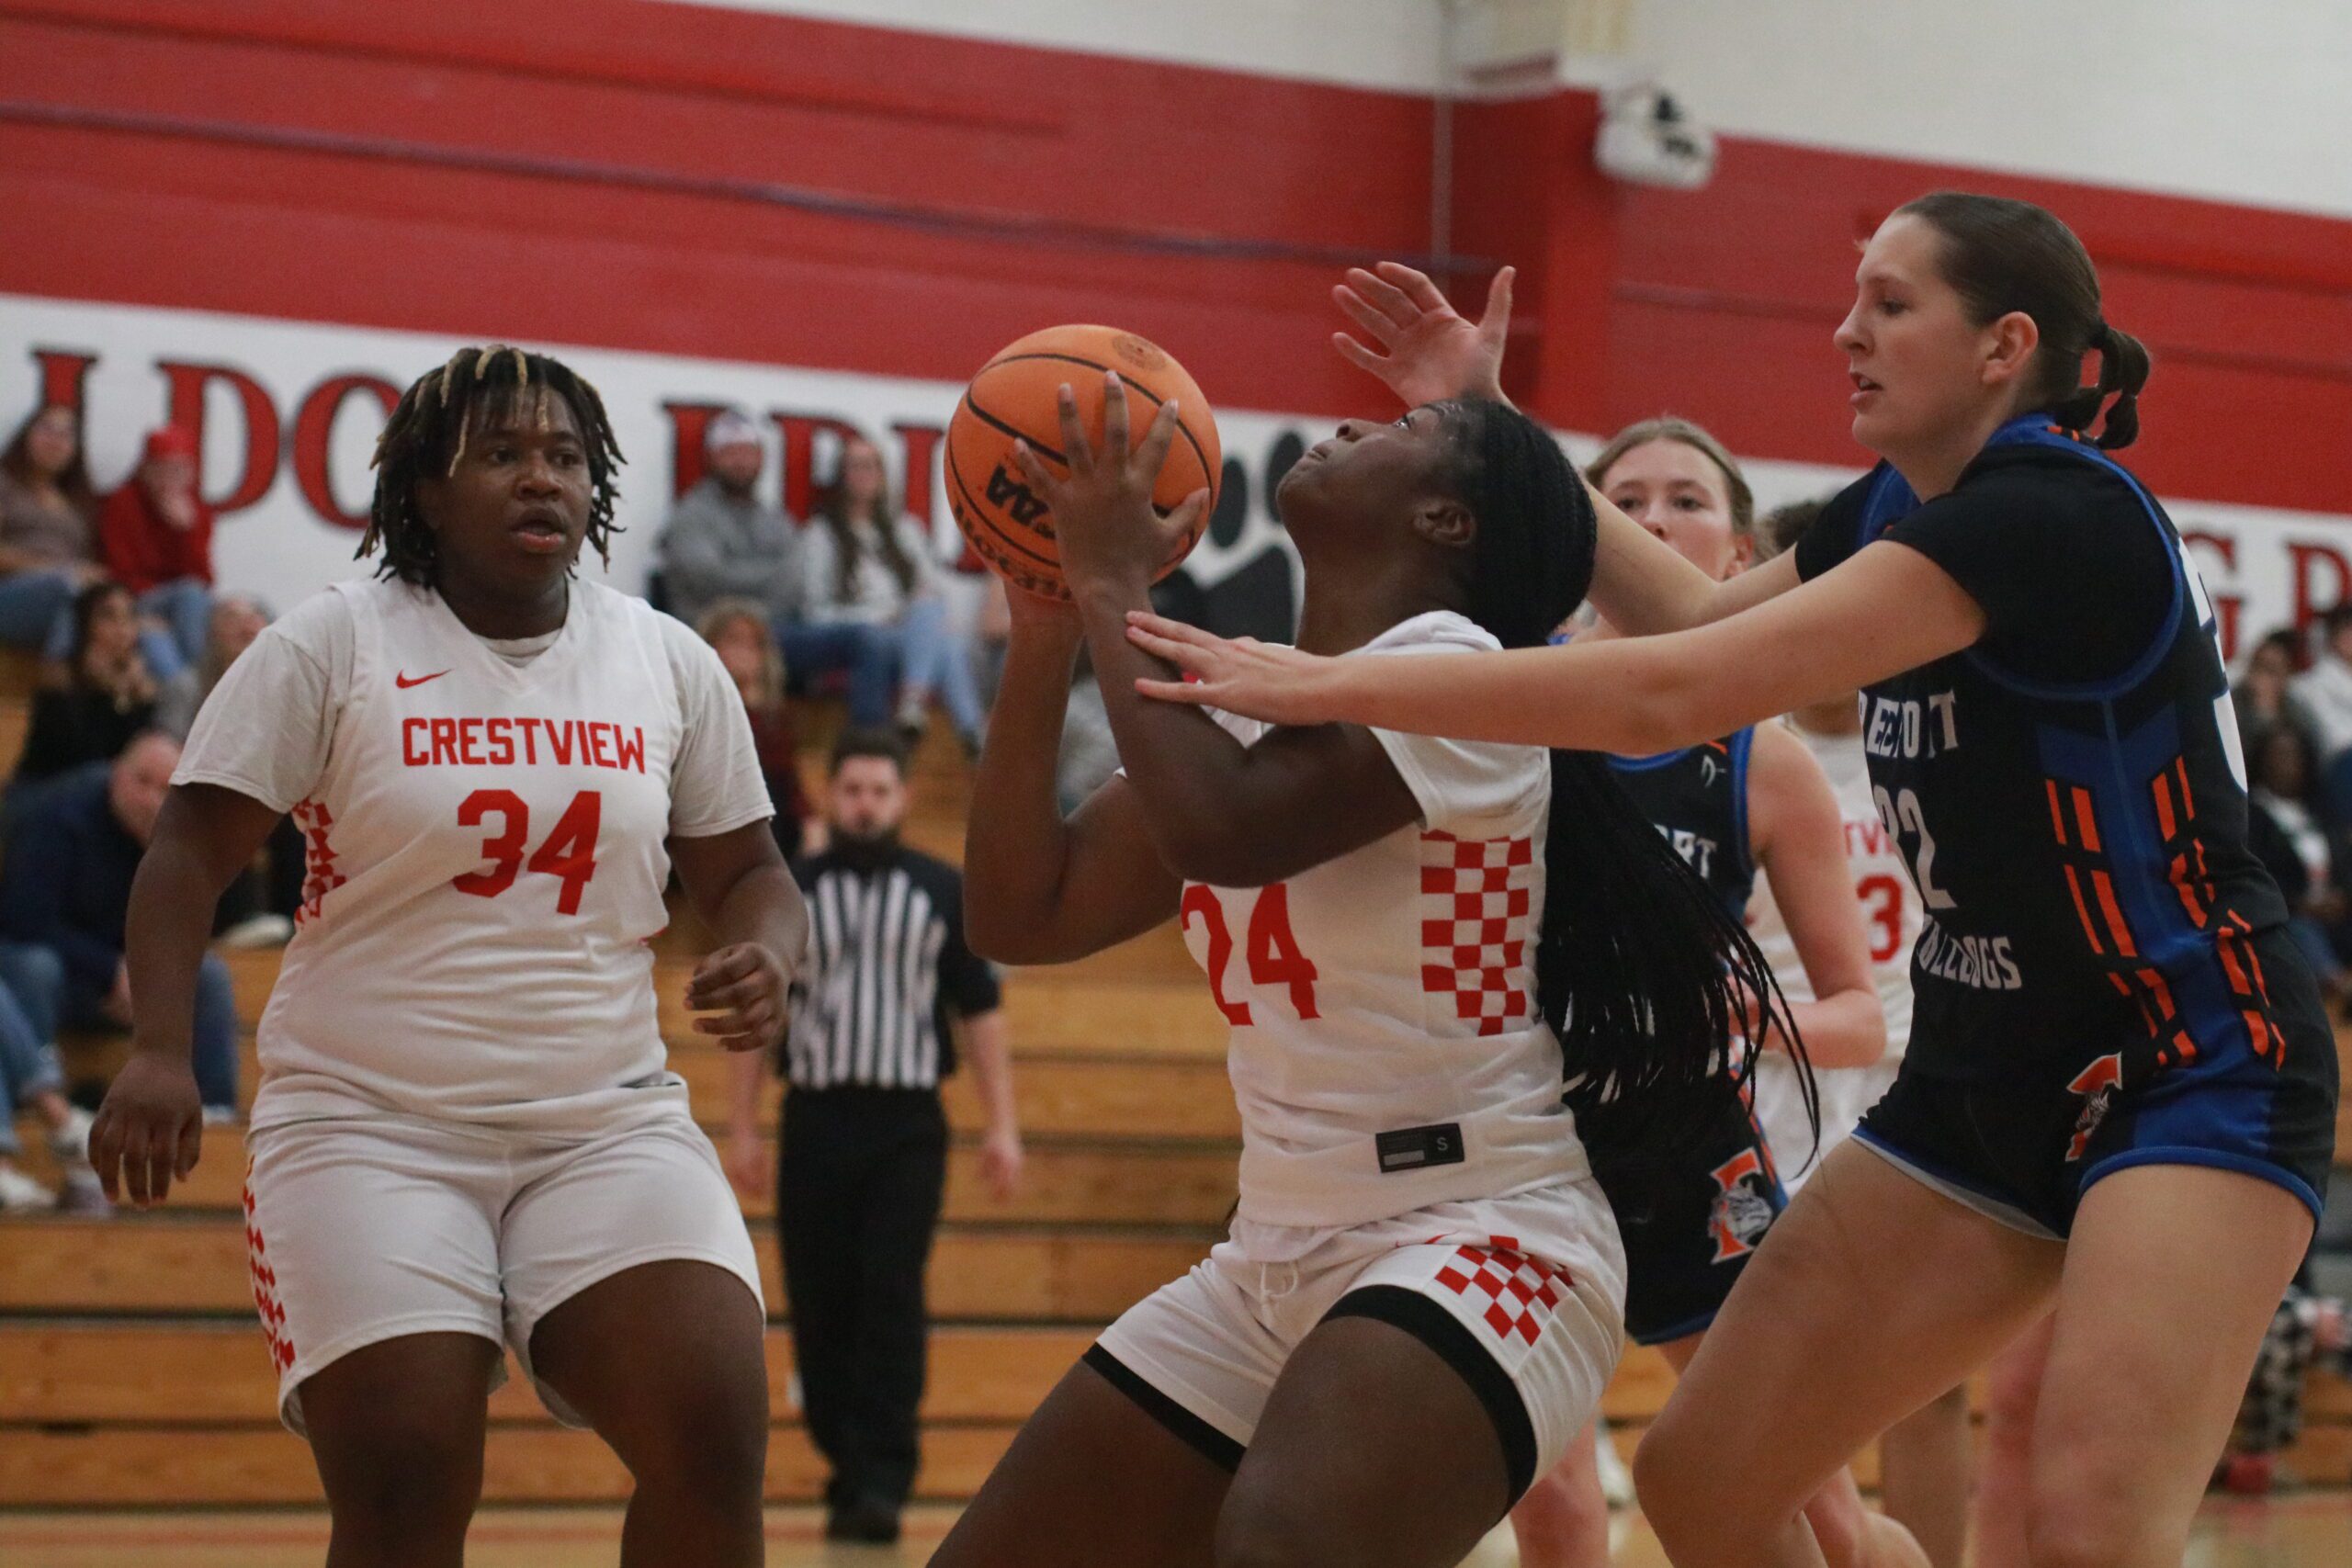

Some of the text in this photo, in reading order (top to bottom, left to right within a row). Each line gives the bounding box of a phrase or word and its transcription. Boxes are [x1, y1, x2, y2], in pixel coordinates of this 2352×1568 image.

[401, 717, 646, 775] CRESTVIEW
[452, 789, 601, 916] 34
[1181, 881, 1322, 1026] 24
[1436, 1136, 1449, 1151] S
